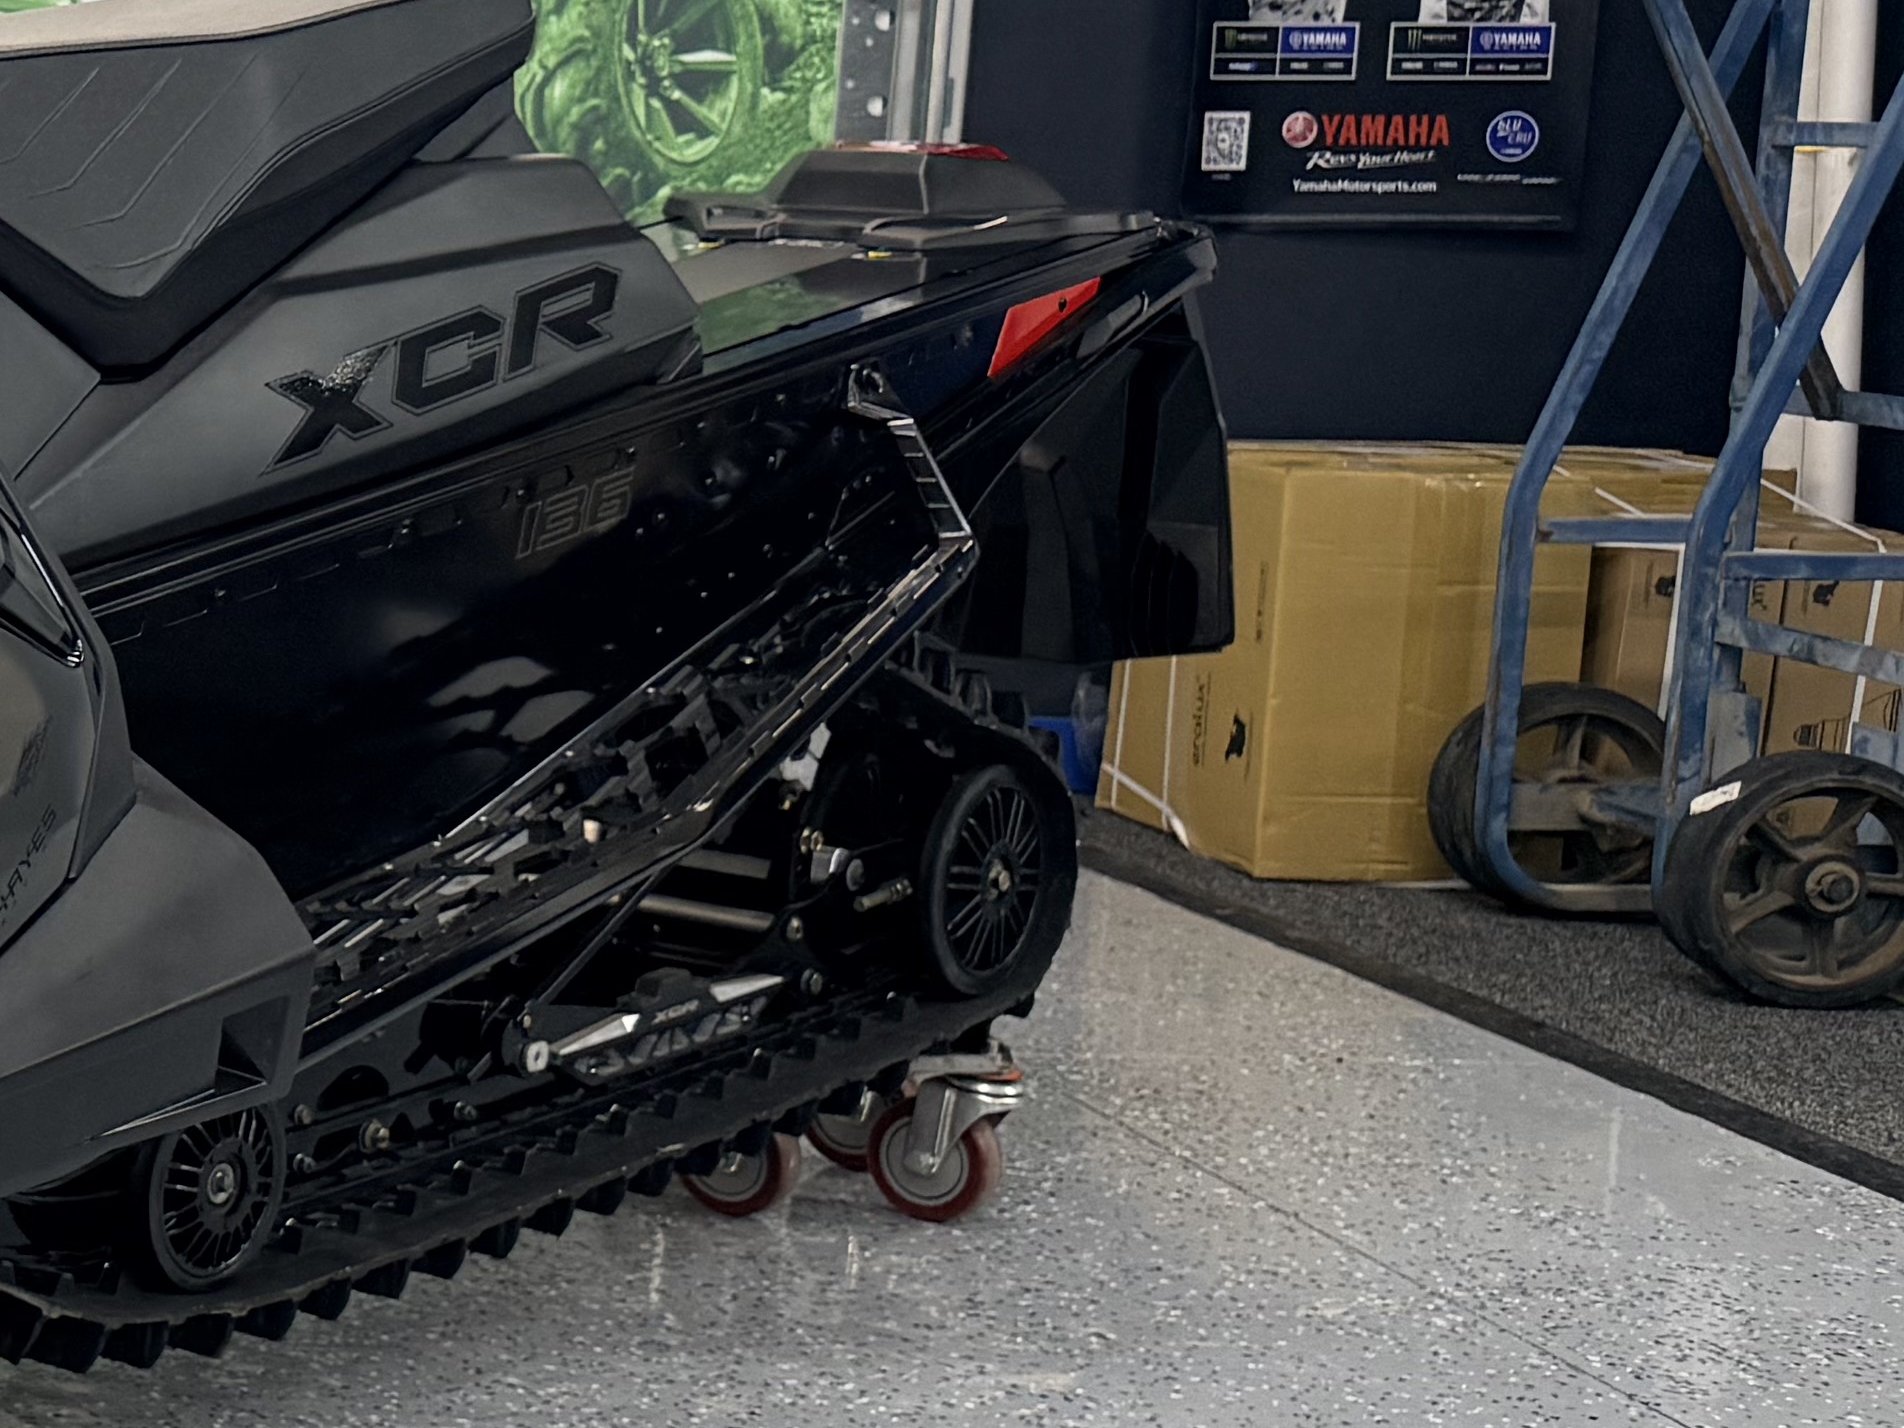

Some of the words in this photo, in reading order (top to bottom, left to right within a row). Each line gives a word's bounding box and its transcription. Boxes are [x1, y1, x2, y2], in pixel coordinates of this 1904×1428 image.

[1302, 31, 1347, 46] YAMAHA
[1493, 31, 1542, 46] YAMAHA
[1321, 113, 1450, 148] YAMAHA
[1357, 151, 1393, 170] Your
[1292, 177, 1437, 195] YamahaMotorsports.com
[258, 261, 623, 476] XCR
